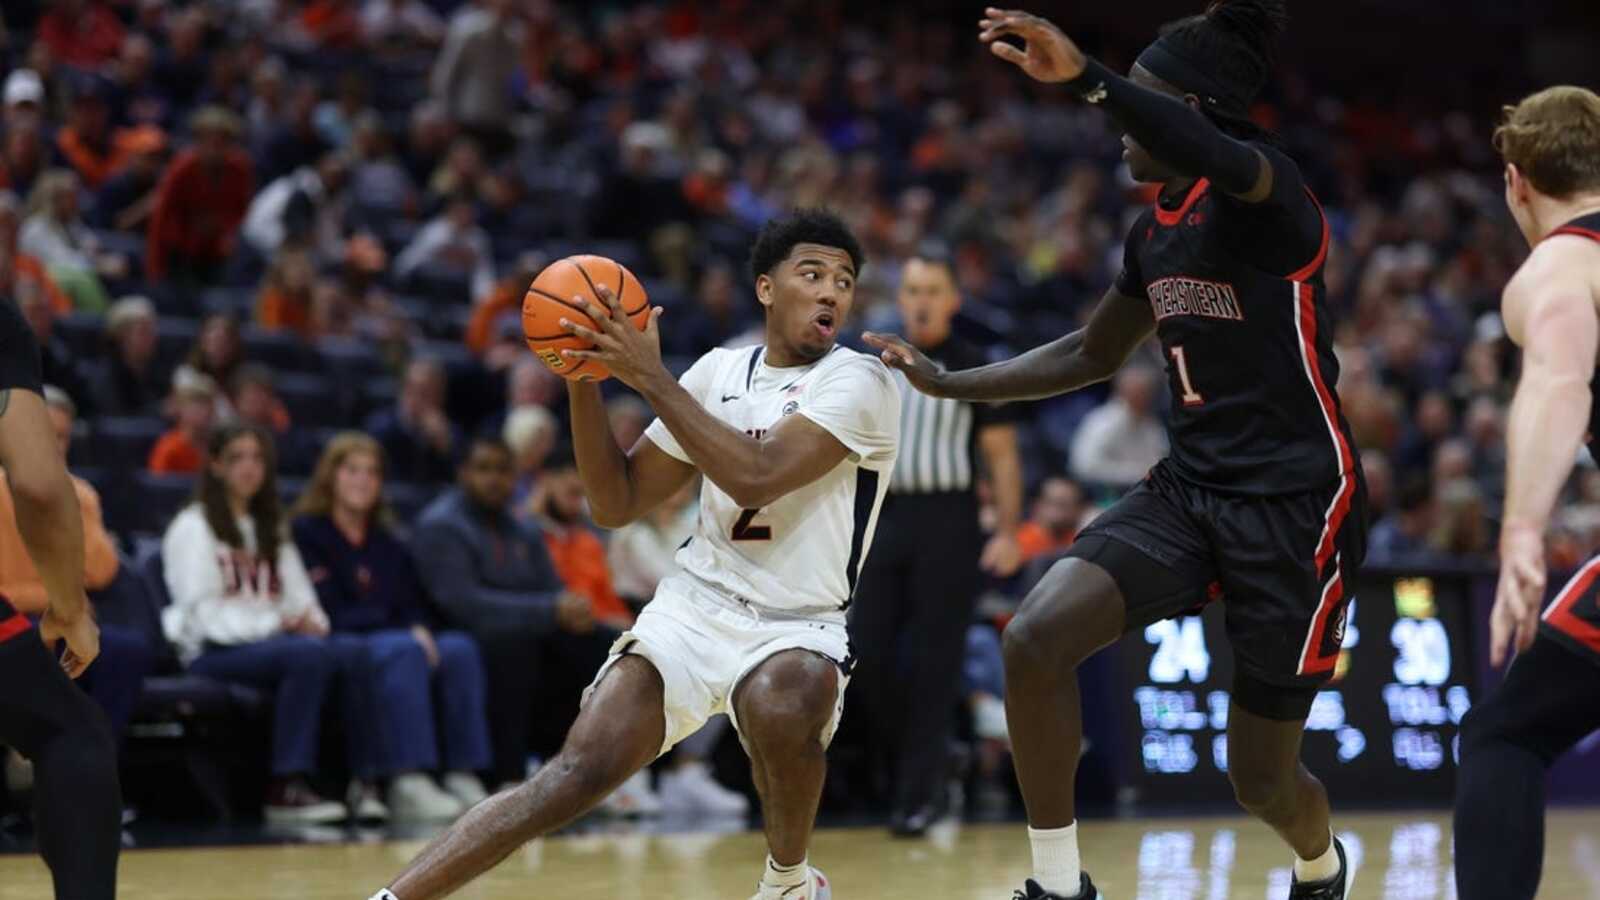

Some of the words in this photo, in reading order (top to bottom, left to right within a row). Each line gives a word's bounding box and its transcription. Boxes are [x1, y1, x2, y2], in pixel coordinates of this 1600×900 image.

[1170, 345, 1204, 405] 1
[1145, 614, 1210, 683] 24
[1392, 617, 1450, 685] 30
